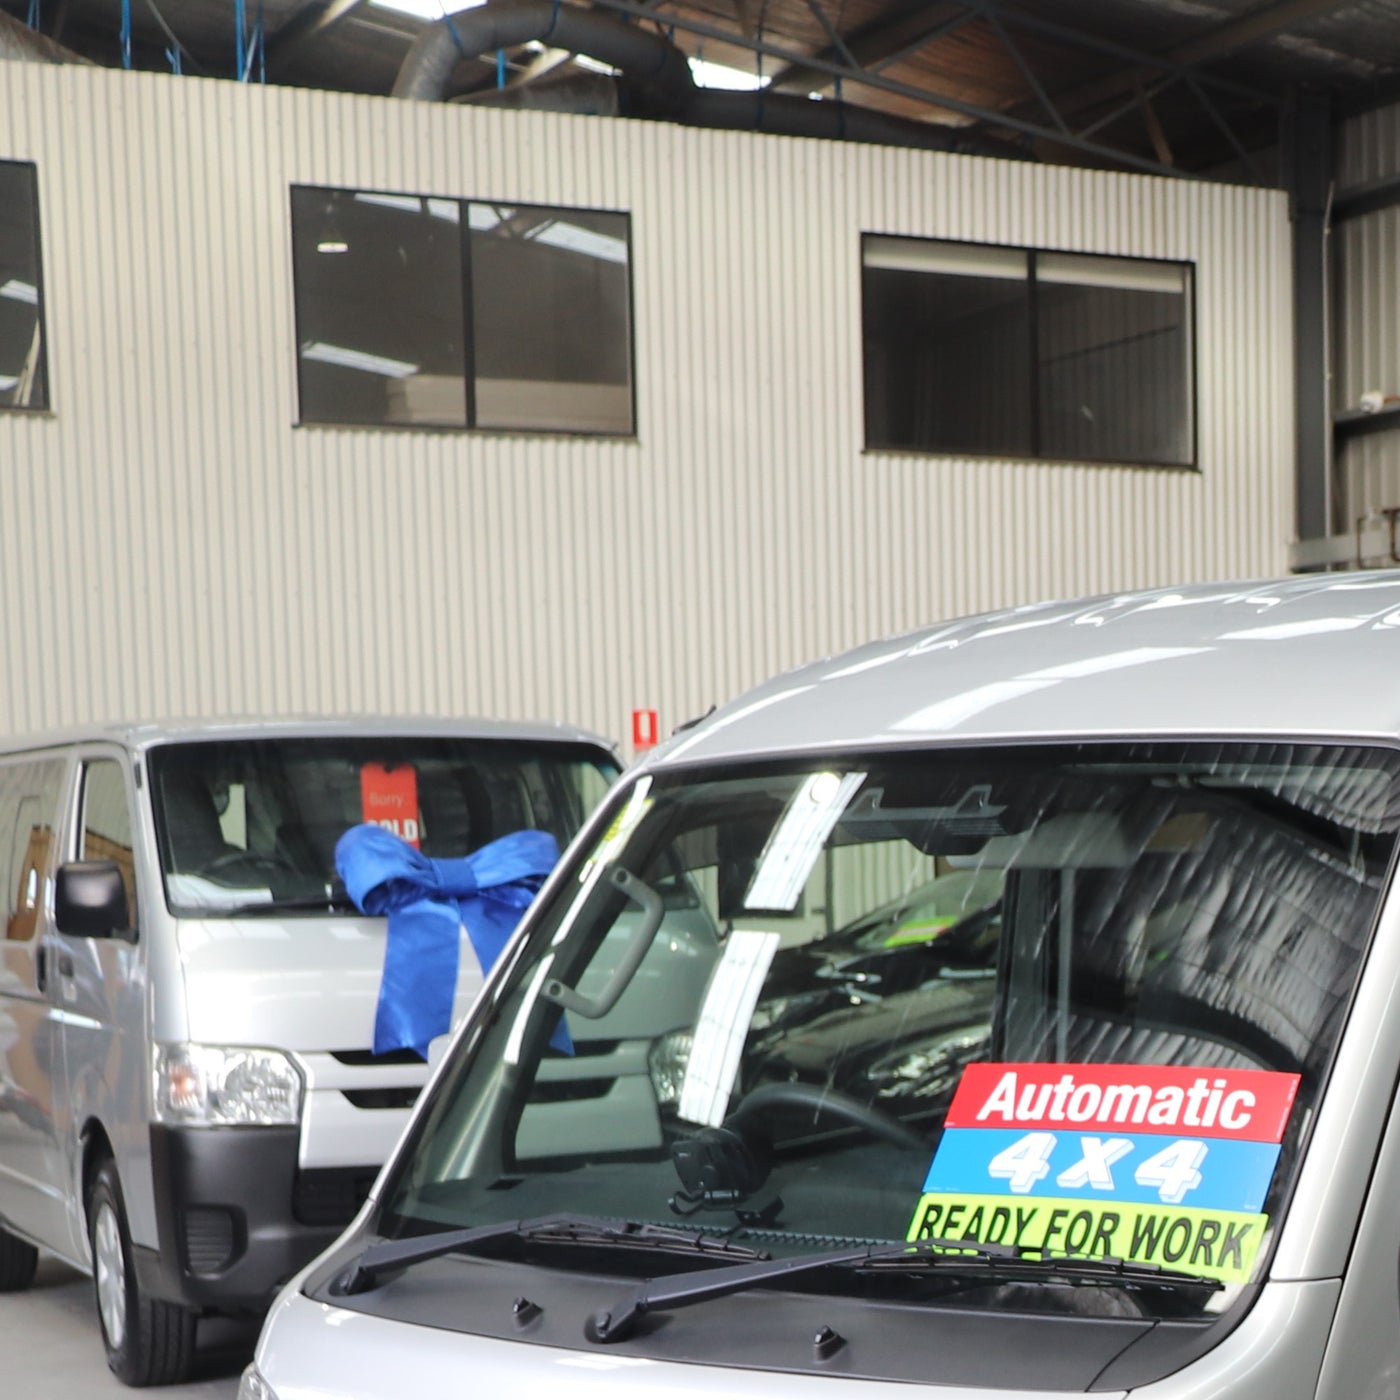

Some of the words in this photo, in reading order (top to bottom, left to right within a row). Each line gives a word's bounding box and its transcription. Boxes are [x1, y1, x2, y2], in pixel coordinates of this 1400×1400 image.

[976, 1072, 1256, 1130] Automatic
[917, 1204, 1038, 1247] READY
[1042, 1208, 1120, 1256] FOR
[1127, 1212, 1253, 1271] WORK
